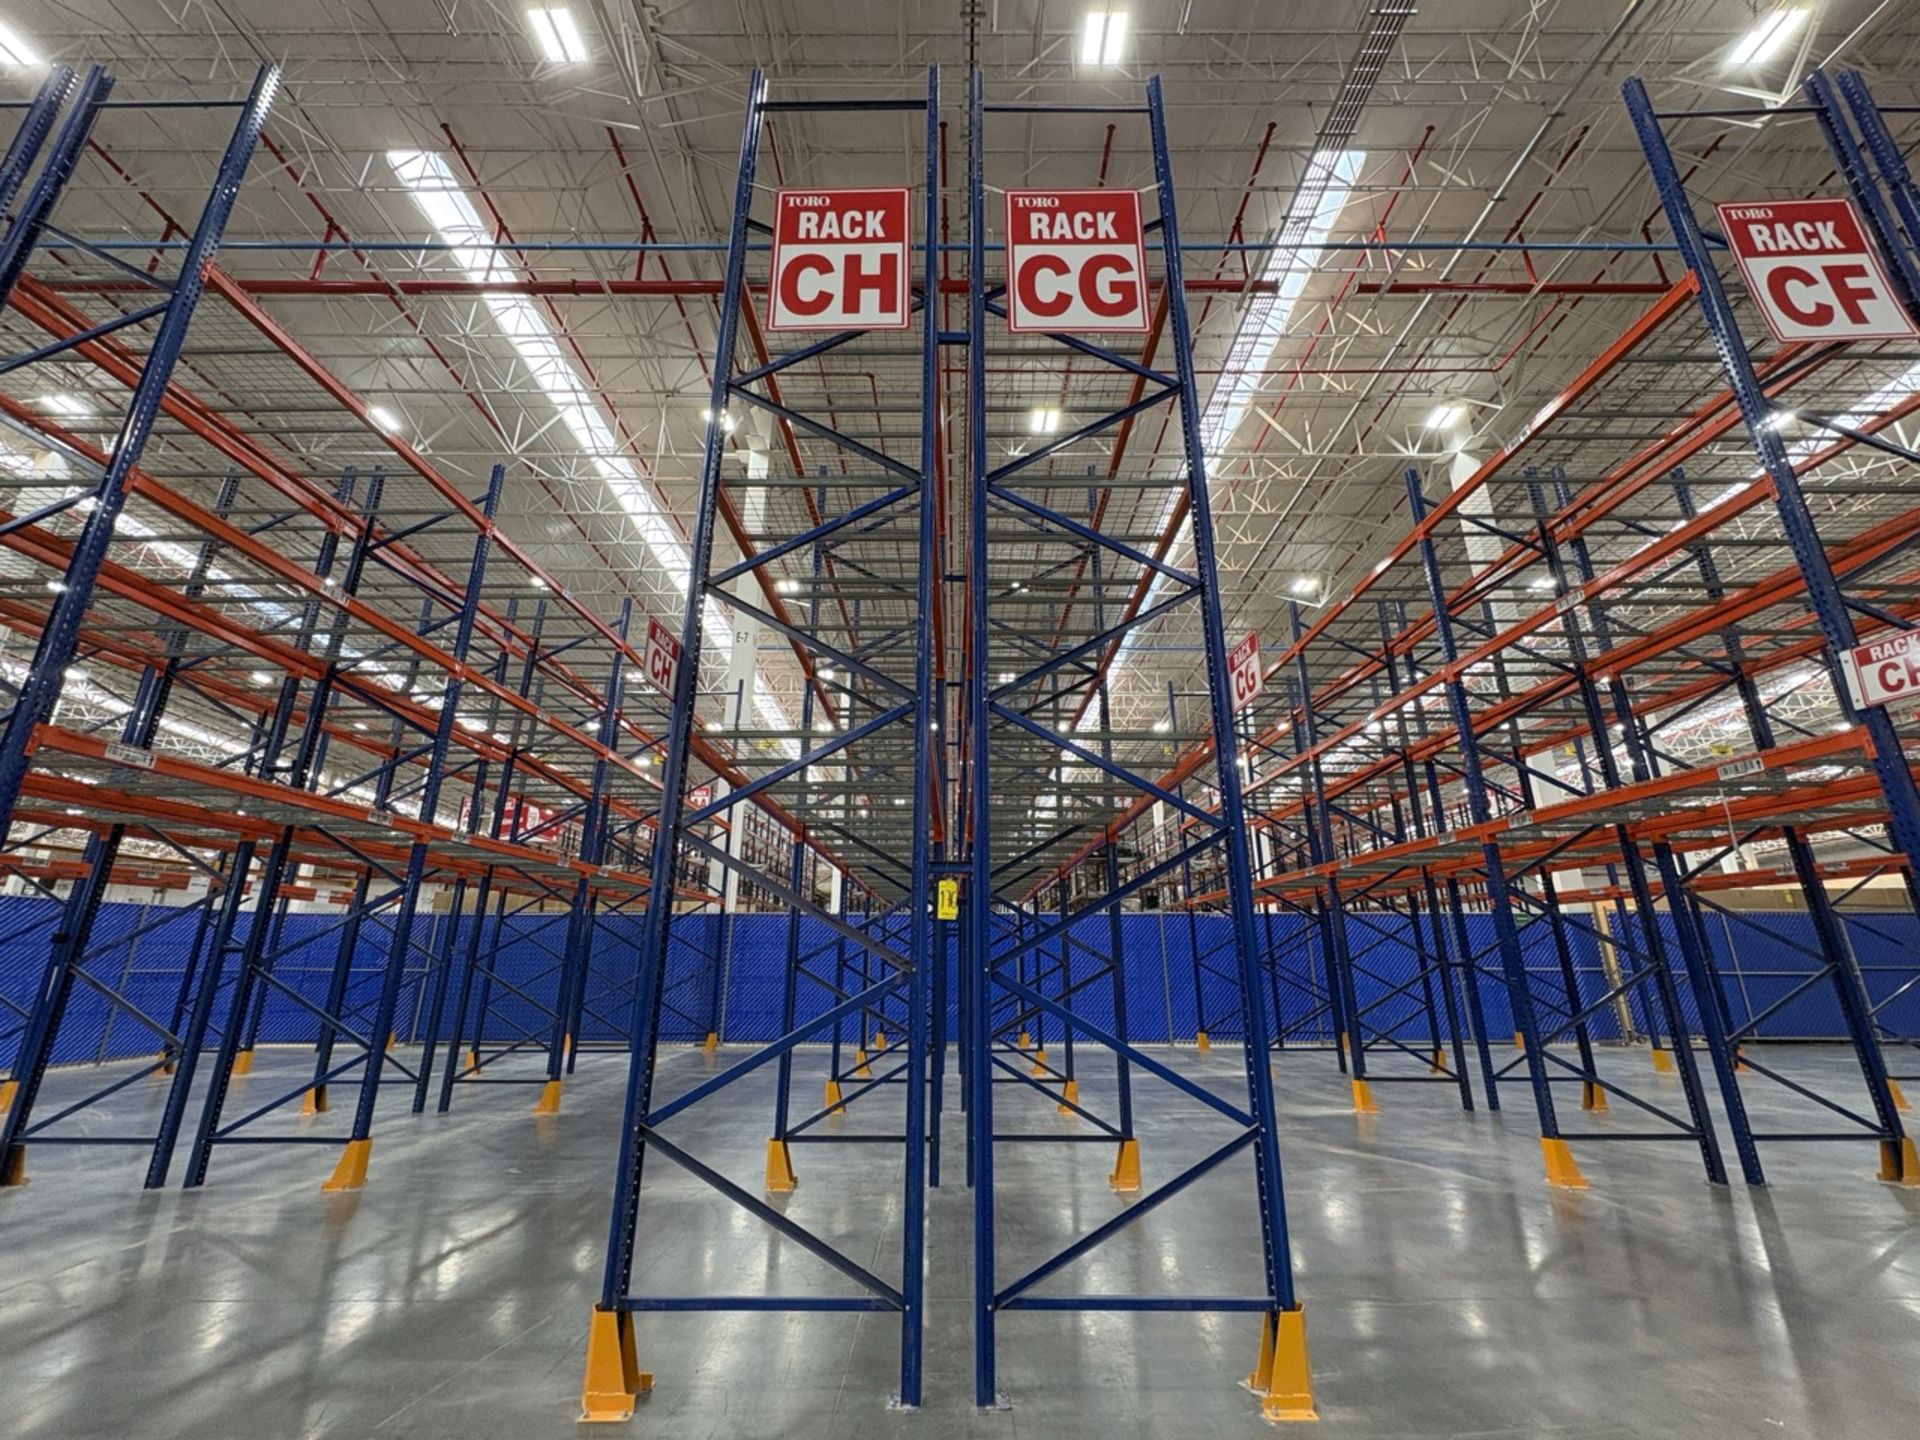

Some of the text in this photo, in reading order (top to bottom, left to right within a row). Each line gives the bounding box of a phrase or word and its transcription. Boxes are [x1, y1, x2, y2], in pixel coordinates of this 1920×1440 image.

[785, 196, 831, 208] TORO
[1015, 197, 1060, 208] TORO
[1726, 208, 1774, 220] TORO
[798, 210, 886, 240] RACK
[1029, 211, 1119, 240] RACK
[1747, 221, 1847, 252] RACK
[780, 253, 898, 316] CH
[1018, 254, 1139, 317] CG
[1766, 264, 1878, 327] CF
[655, 627, 674, 656] RACK
[1232, 640, 1252, 669] RACK
[1869, 634, 1919, 662] RACK
[651, 647, 673, 690] CH
[1236, 660, 1256, 701] CG
